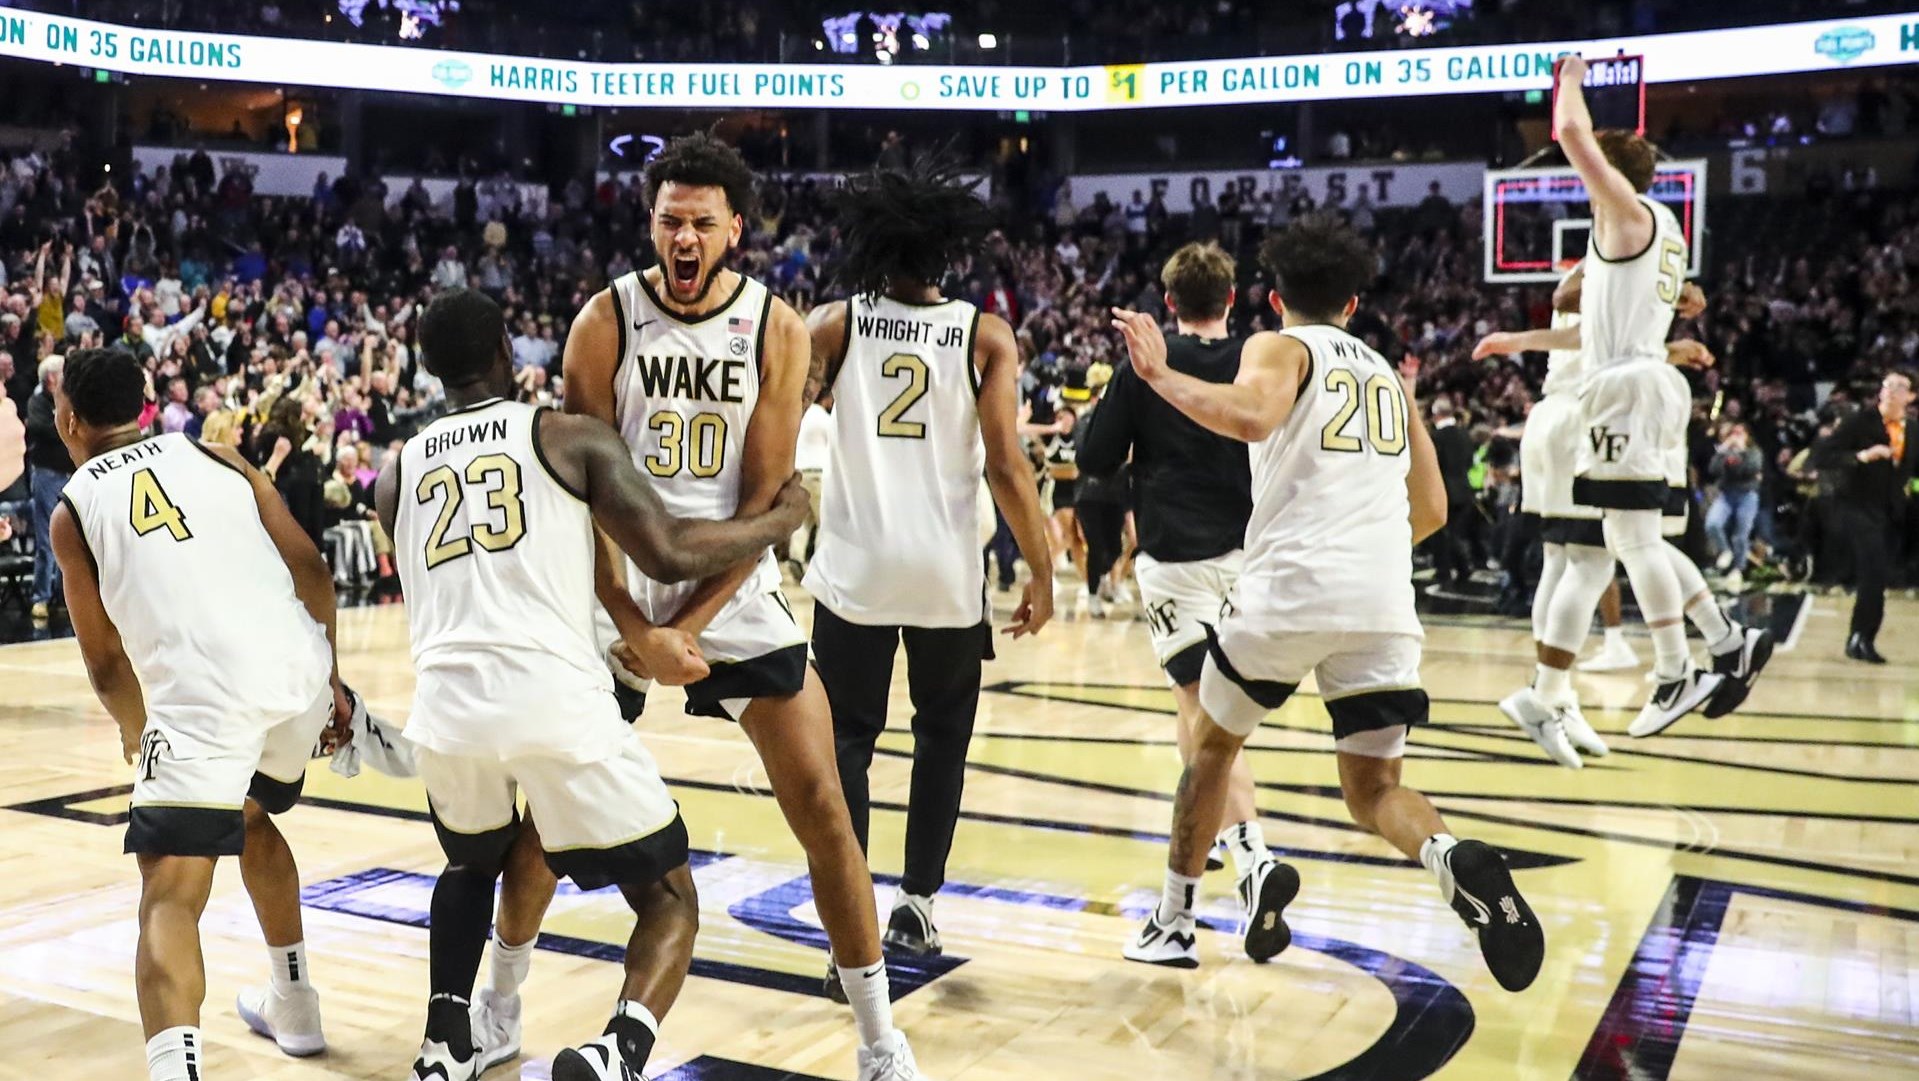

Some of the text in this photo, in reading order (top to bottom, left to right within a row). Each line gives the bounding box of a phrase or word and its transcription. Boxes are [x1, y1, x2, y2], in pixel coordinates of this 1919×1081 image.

[47, 23, 77, 52] ON
[90, 30, 117, 58] 35
[130, 37, 241, 68] GALLONS
[490, 64, 578, 94] HARRIS
[591, 72, 675, 95] TEETER
[688, 72, 742, 96] FUEL
[755, 73, 844, 97] POINTS
[939, 75, 1001, 98] SAVE
[1014, 76, 1046, 98] UP
[1061, 76, 1090, 98] TO
[1112, 71, 1136, 99] $1
[1161, 69, 1207, 94] PER
[1223, 64, 1320, 91] GALLON
[1346, 61, 1381, 85] ON
[1397, 58, 1431, 82] 35
[1447, 51, 1569, 81] GALLON
[1731, 149, 1767, 194] 6
[1657, 236, 1688, 308] 5
[857, 315, 964, 348] WRIGHT JR
[637, 355, 746, 404] WAKE
[877, 352, 930, 439] 2
[1321, 368, 1406, 457] 20
[87, 442, 163, 480] NEATH
[424, 419, 508, 459] BROWN
[645, 410, 728, 478] 30
[129, 467, 194, 542] 4
[416, 452, 528, 571] 23
